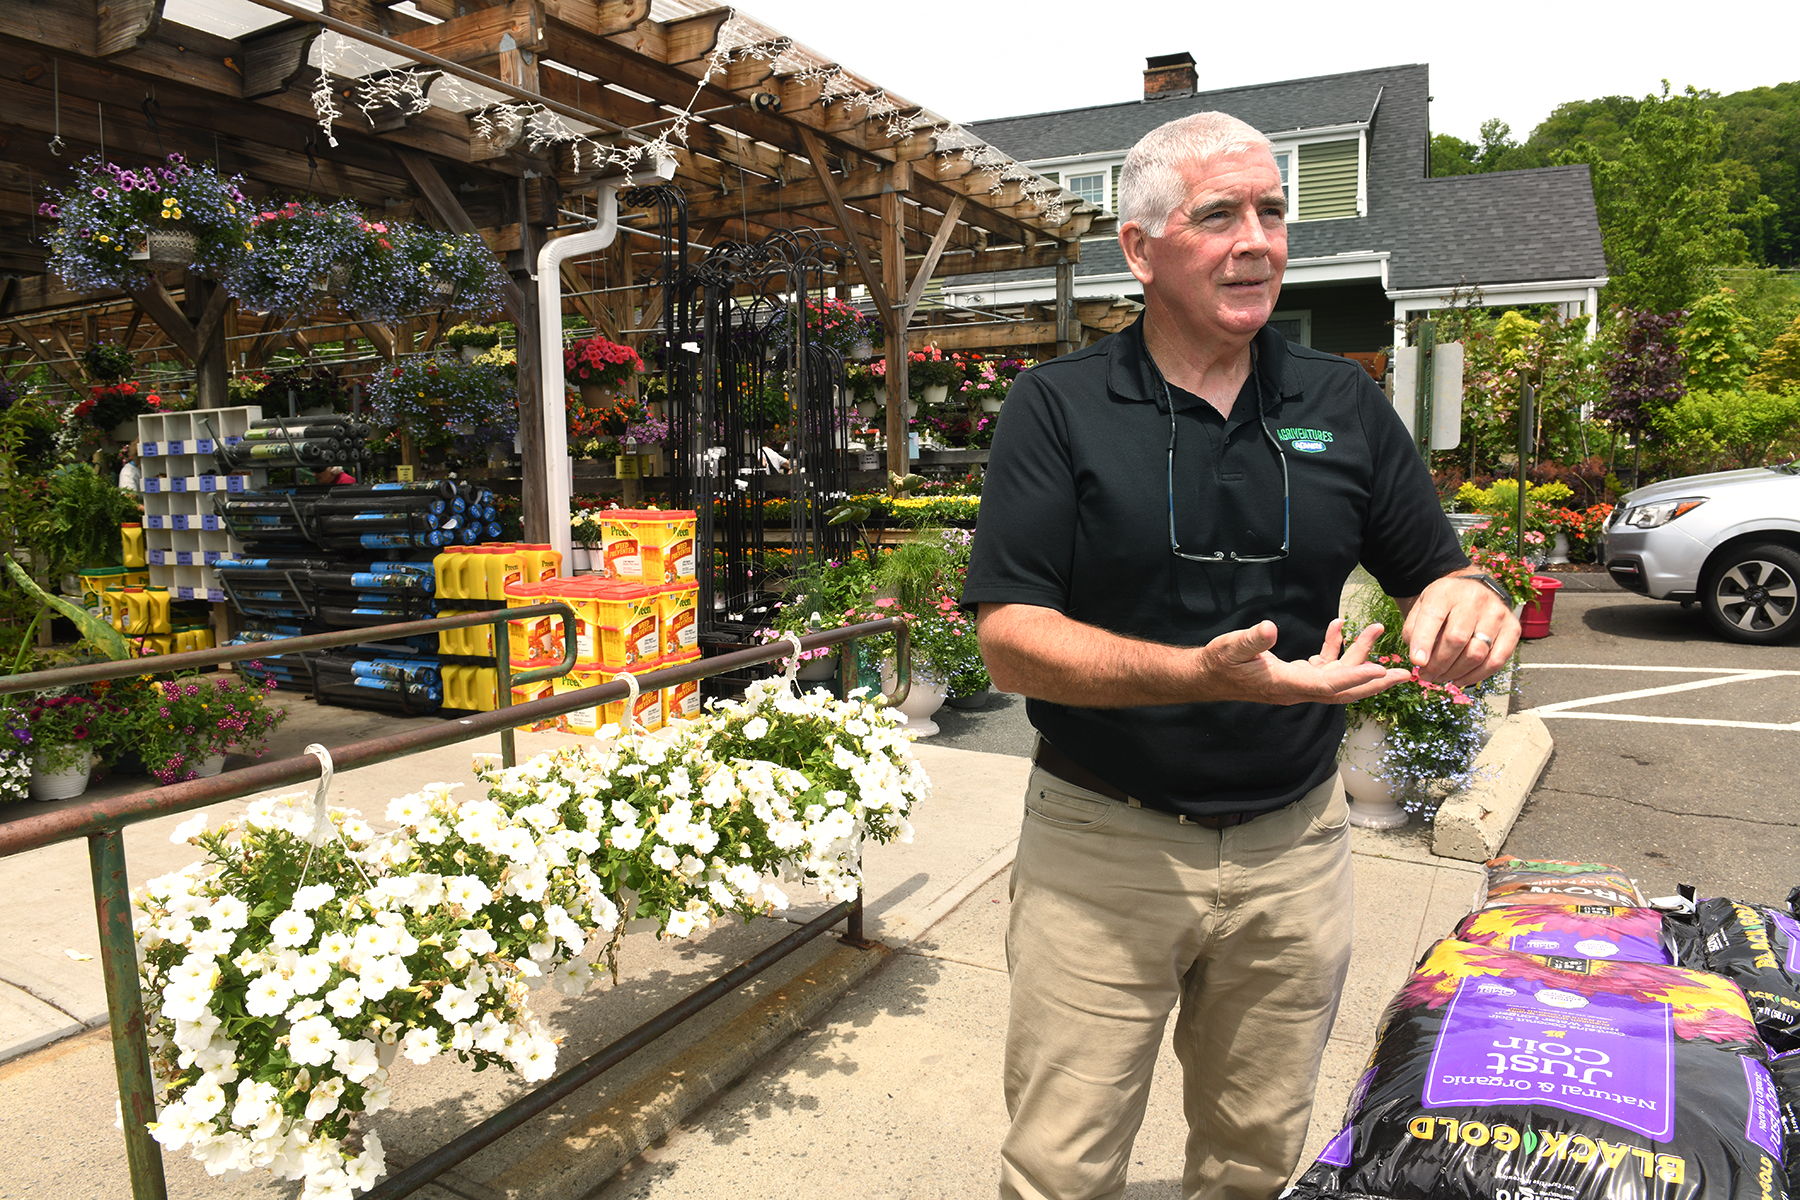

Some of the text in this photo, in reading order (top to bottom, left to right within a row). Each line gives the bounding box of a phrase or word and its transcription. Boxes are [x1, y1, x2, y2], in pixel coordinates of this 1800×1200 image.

[1277, 428, 1333, 442] AGRIVENTURES
[614, 542, 630, 550] WEED
[676, 542, 688, 550] WEED
[610, 548, 635, 558] PREVENTER
[679, 612, 690, 620] WEED
[638, 620, 650, 630] WEED
[1494, 1012, 1539, 1020] Longer
[1541, 1017, 1581, 1026] Water
[1516, 1017, 1566, 1028] Coconut
[1584, 1024, 1620, 1032] Holds
[1569, 1025, 1625, 1036] Contains
[1492, 1036, 1610, 1066] Coir
[1486, 1052, 1613, 1085] Just
[1754, 1071, 1764, 1098] Organic
[1442, 1074, 1656, 1110] Natural & Organic
[1764, 1073, 1779, 1111] Coir
[1757, 1103, 1767, 1132] Natural
[1407, 1116, 1686, 1184] BLACK GOLD
[1758, 1156, 1773, 1192] GOLD
